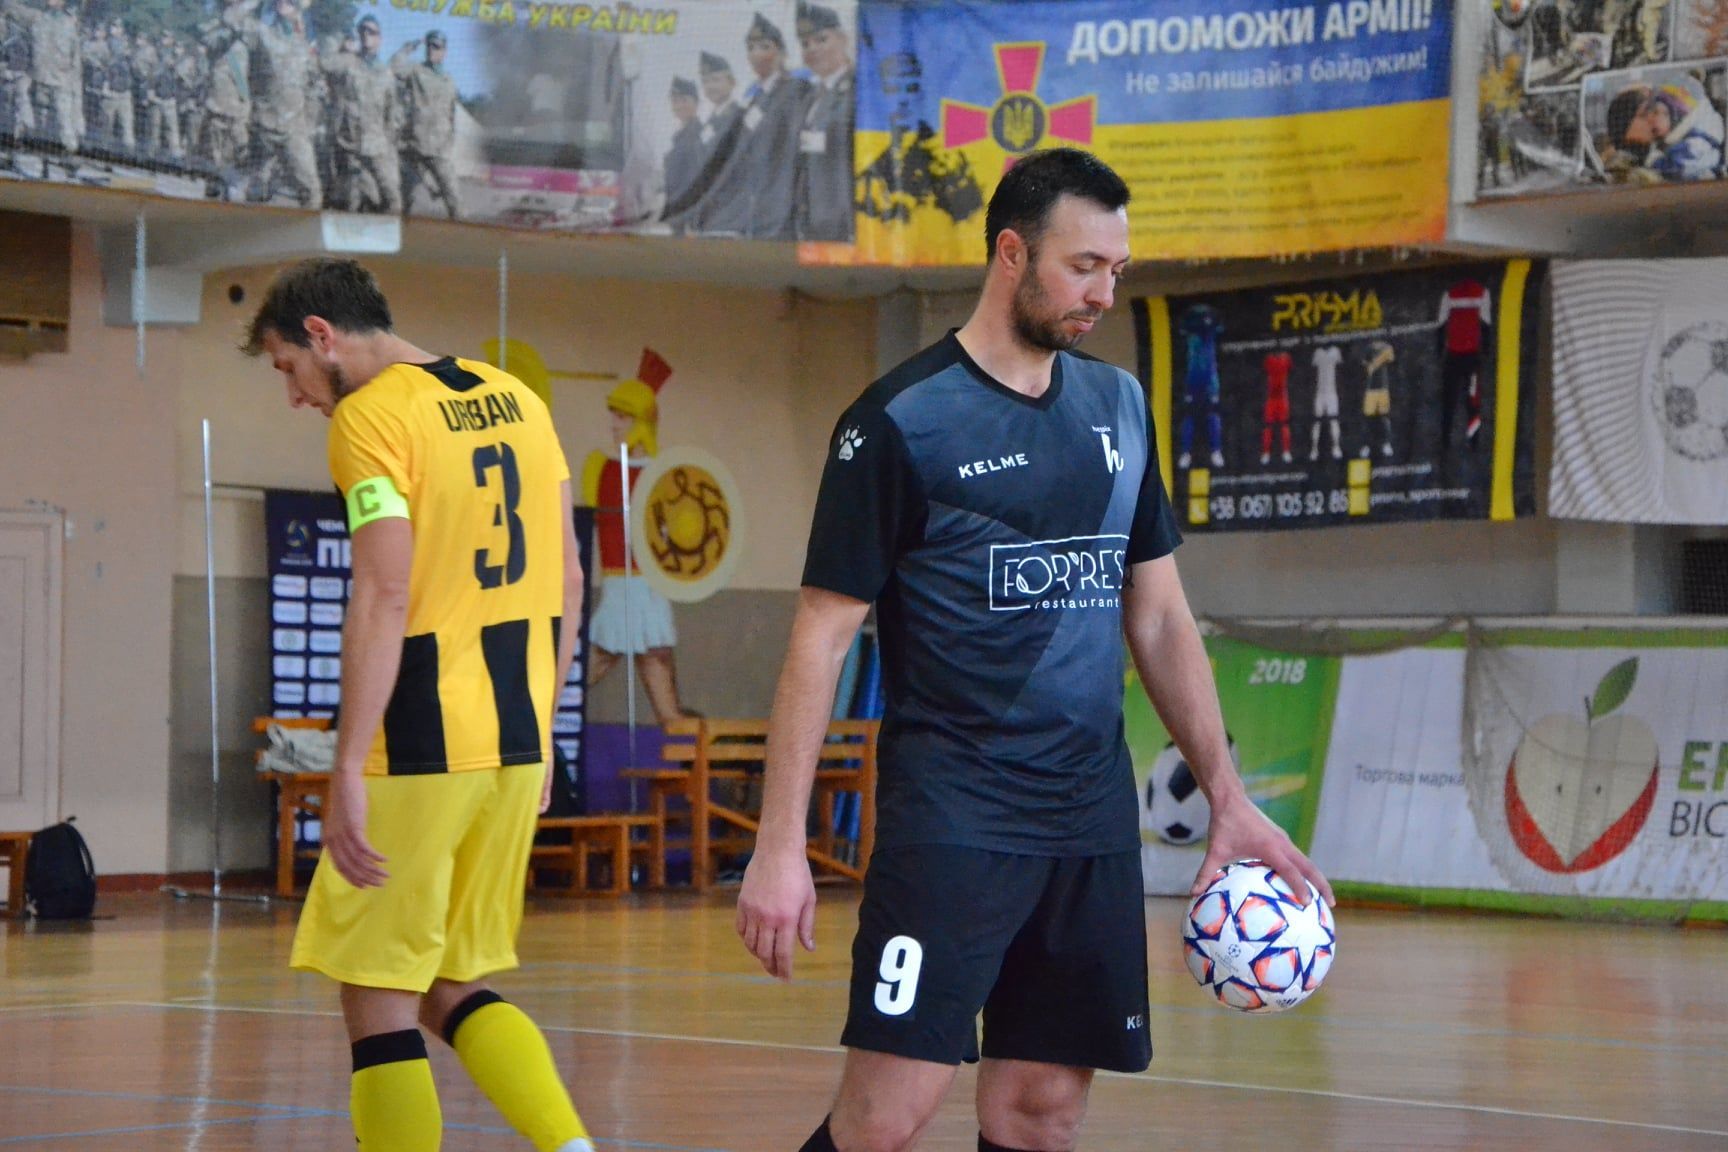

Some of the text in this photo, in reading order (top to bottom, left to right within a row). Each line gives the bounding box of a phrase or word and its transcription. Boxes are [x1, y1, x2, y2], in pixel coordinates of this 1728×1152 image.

[529, 3, 679, 34] УКРАЇНИ
[1067, 8, 1314, 65] ДОПОМОЖИ
[1126, 46, 1429, 94] Не залишайся байдужим!
[1272, 290, 1382, 331] PRISMA
[438, 391, 525, 432] URBAN
[958, 453, 1029, 479] KELME
[355, 484, 381, 518] C
[472, 441, 526, 590] 3
[1276, 492, 1303, 517] 105
[1034, 597, 1119, 610] restaurant
[1250, 658, 1307, 684] 2018
[1356, 764, 1466, 788] Торгова марка
[874, 935, 923, 1016] 9
[1126, 1014, 1144, 1030] KE
